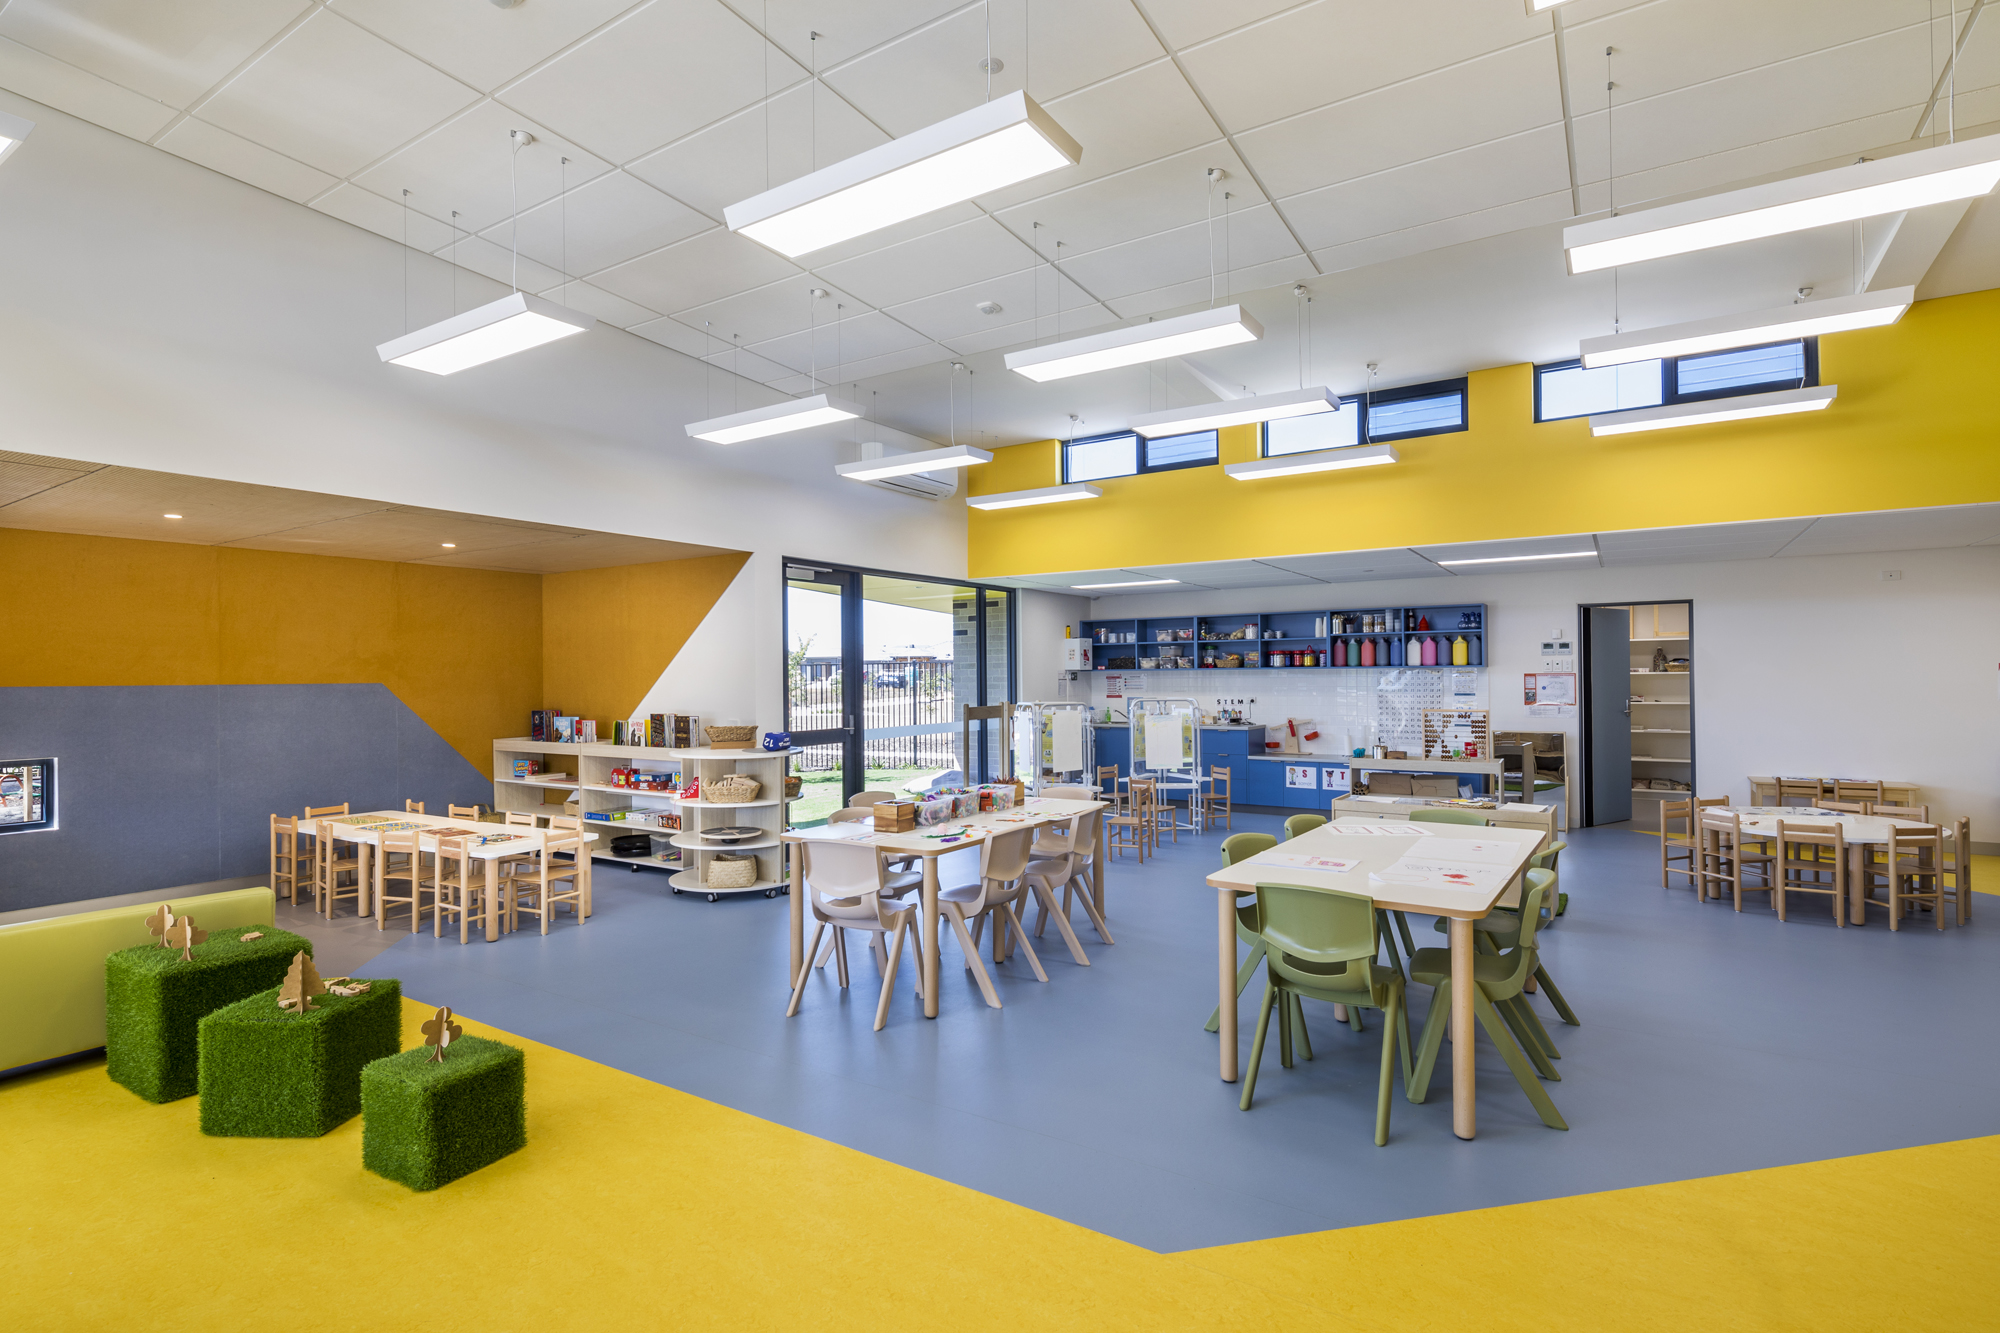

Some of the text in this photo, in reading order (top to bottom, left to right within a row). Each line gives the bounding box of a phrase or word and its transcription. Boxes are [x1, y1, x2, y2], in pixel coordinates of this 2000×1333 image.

[764, 738, 773, 747] 12
[1302, 769, 1307, 778] S
[1340, 772, 1345, 780] T
